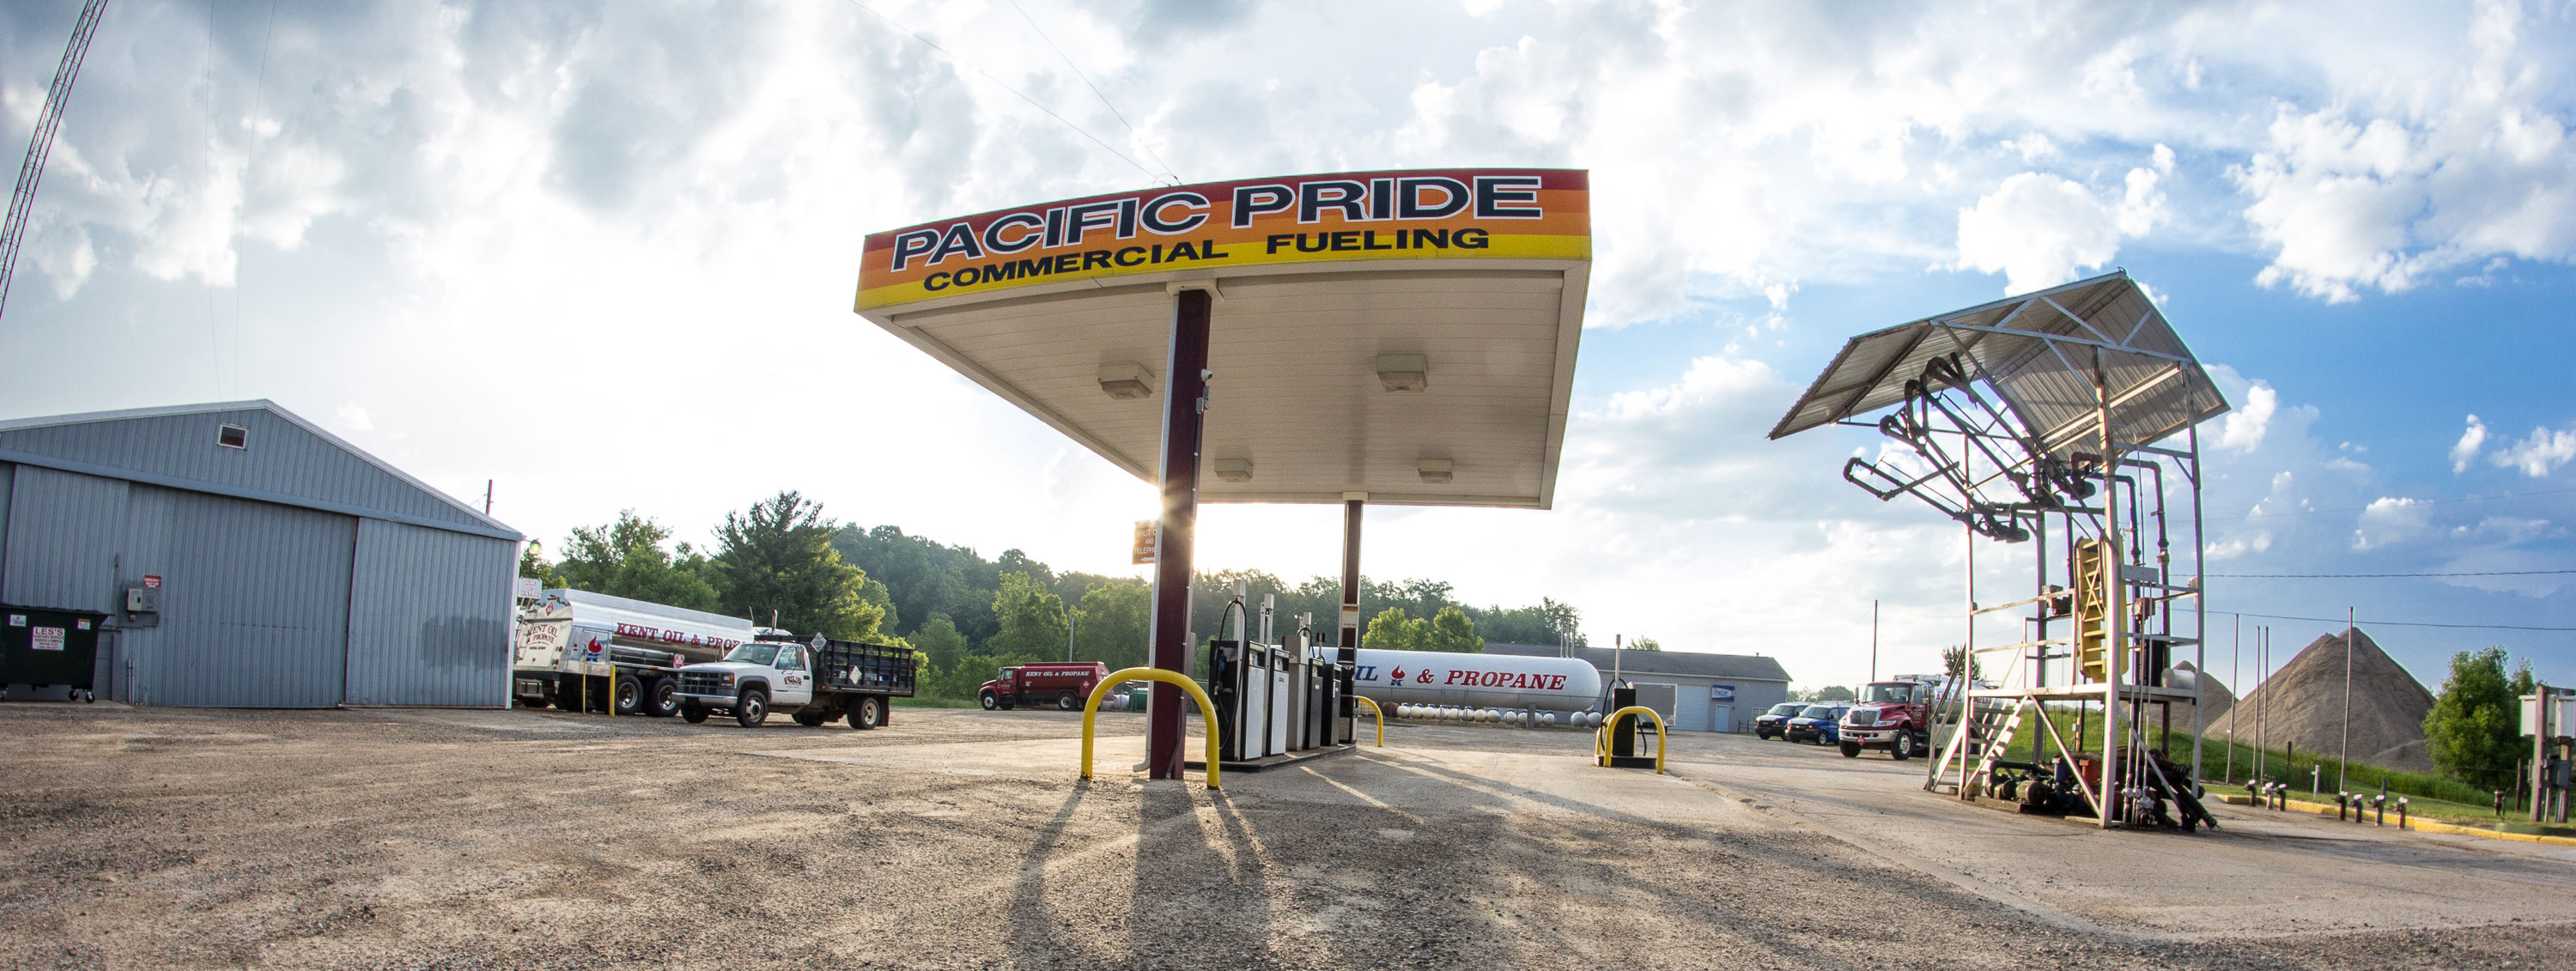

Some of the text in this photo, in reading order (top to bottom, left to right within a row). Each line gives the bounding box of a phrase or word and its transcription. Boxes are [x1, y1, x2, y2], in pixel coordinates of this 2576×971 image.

[890, 175, 1543, 272] PACIFIC PRIDE
[923, 228, 1489, 292] COMMERCIAL FUELING
[1133, 546, 1156, 555] TELEPH
[35, 628, 64, 636] LES'S
[548, 625, 558, 638] OIL
[614, 622, 745, 651] KENT OIL & PROP
[1416, 668, 1435, 684] &
[1443, 670, 1568, 690] PROPANE
